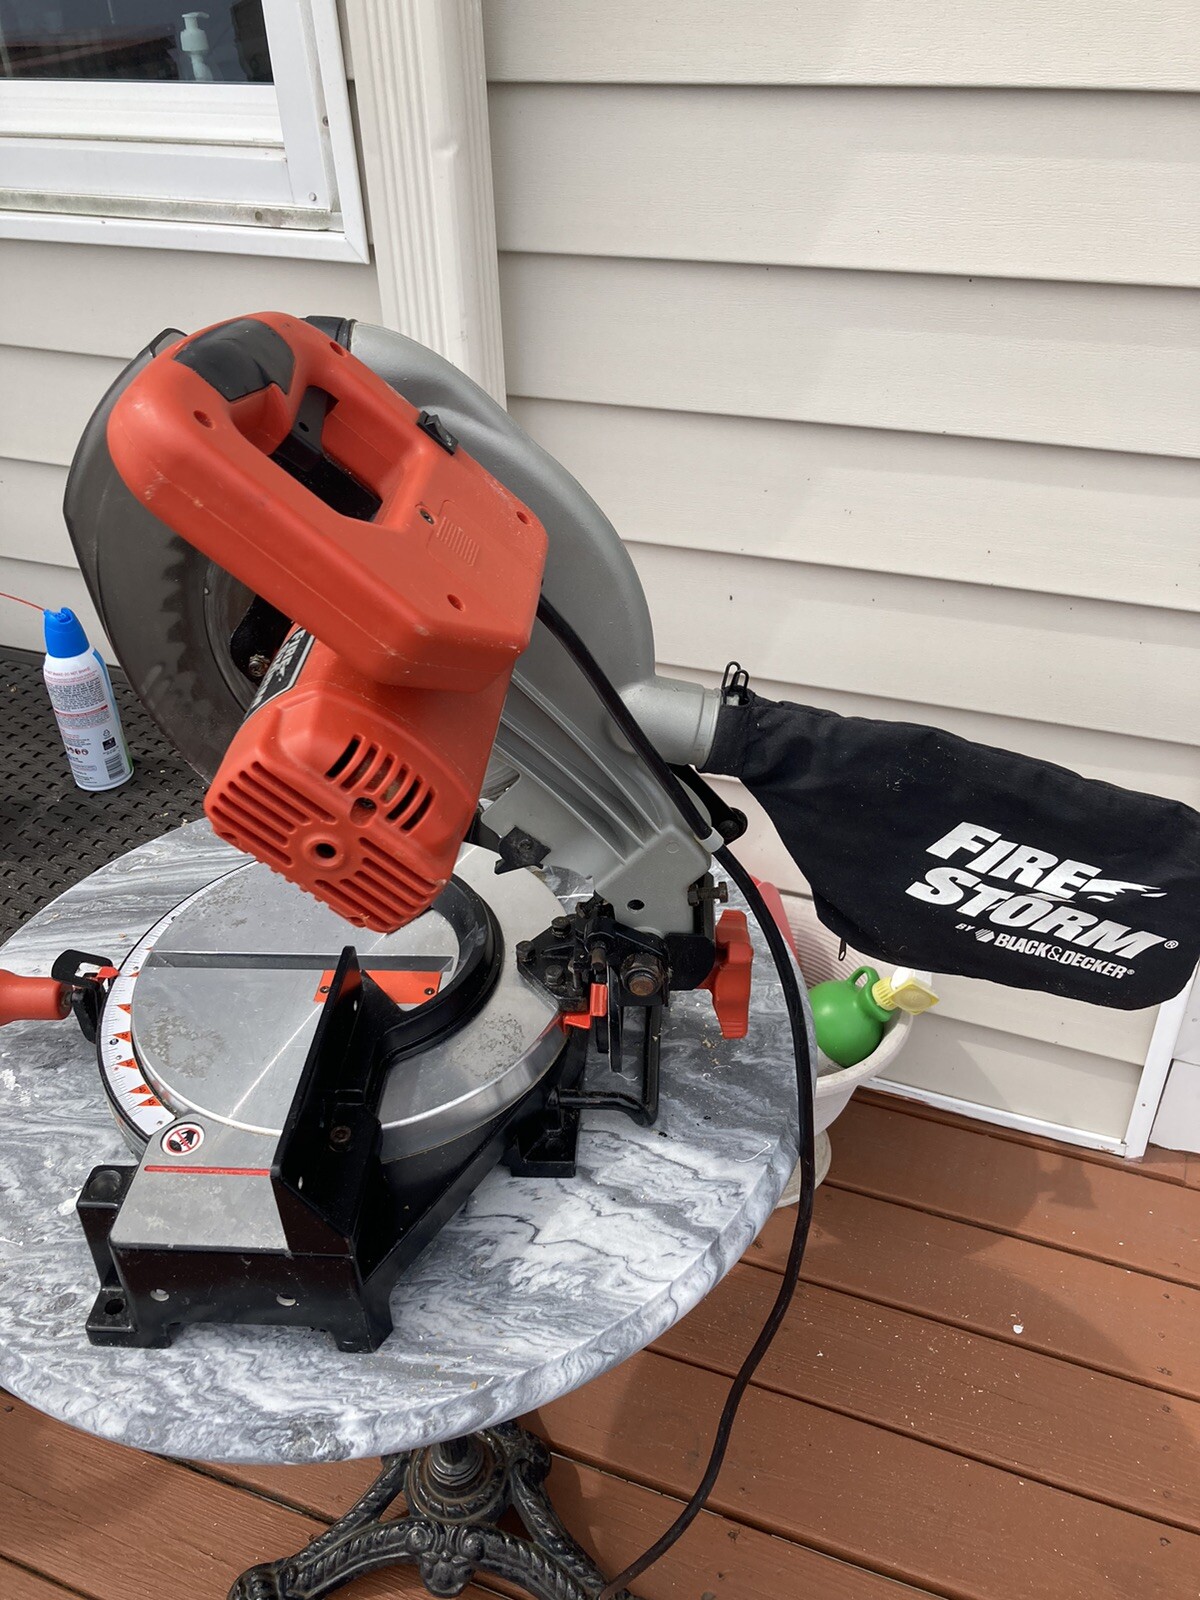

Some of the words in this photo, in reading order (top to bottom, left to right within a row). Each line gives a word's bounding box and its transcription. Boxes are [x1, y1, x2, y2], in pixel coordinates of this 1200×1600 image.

[925, 821, 1102, 899] FIRE
[905, 866, 1167, 959] STORM
[955, 922, 975, 932] BY
[994, 932, 1127, 979] BLACK&DECKER
